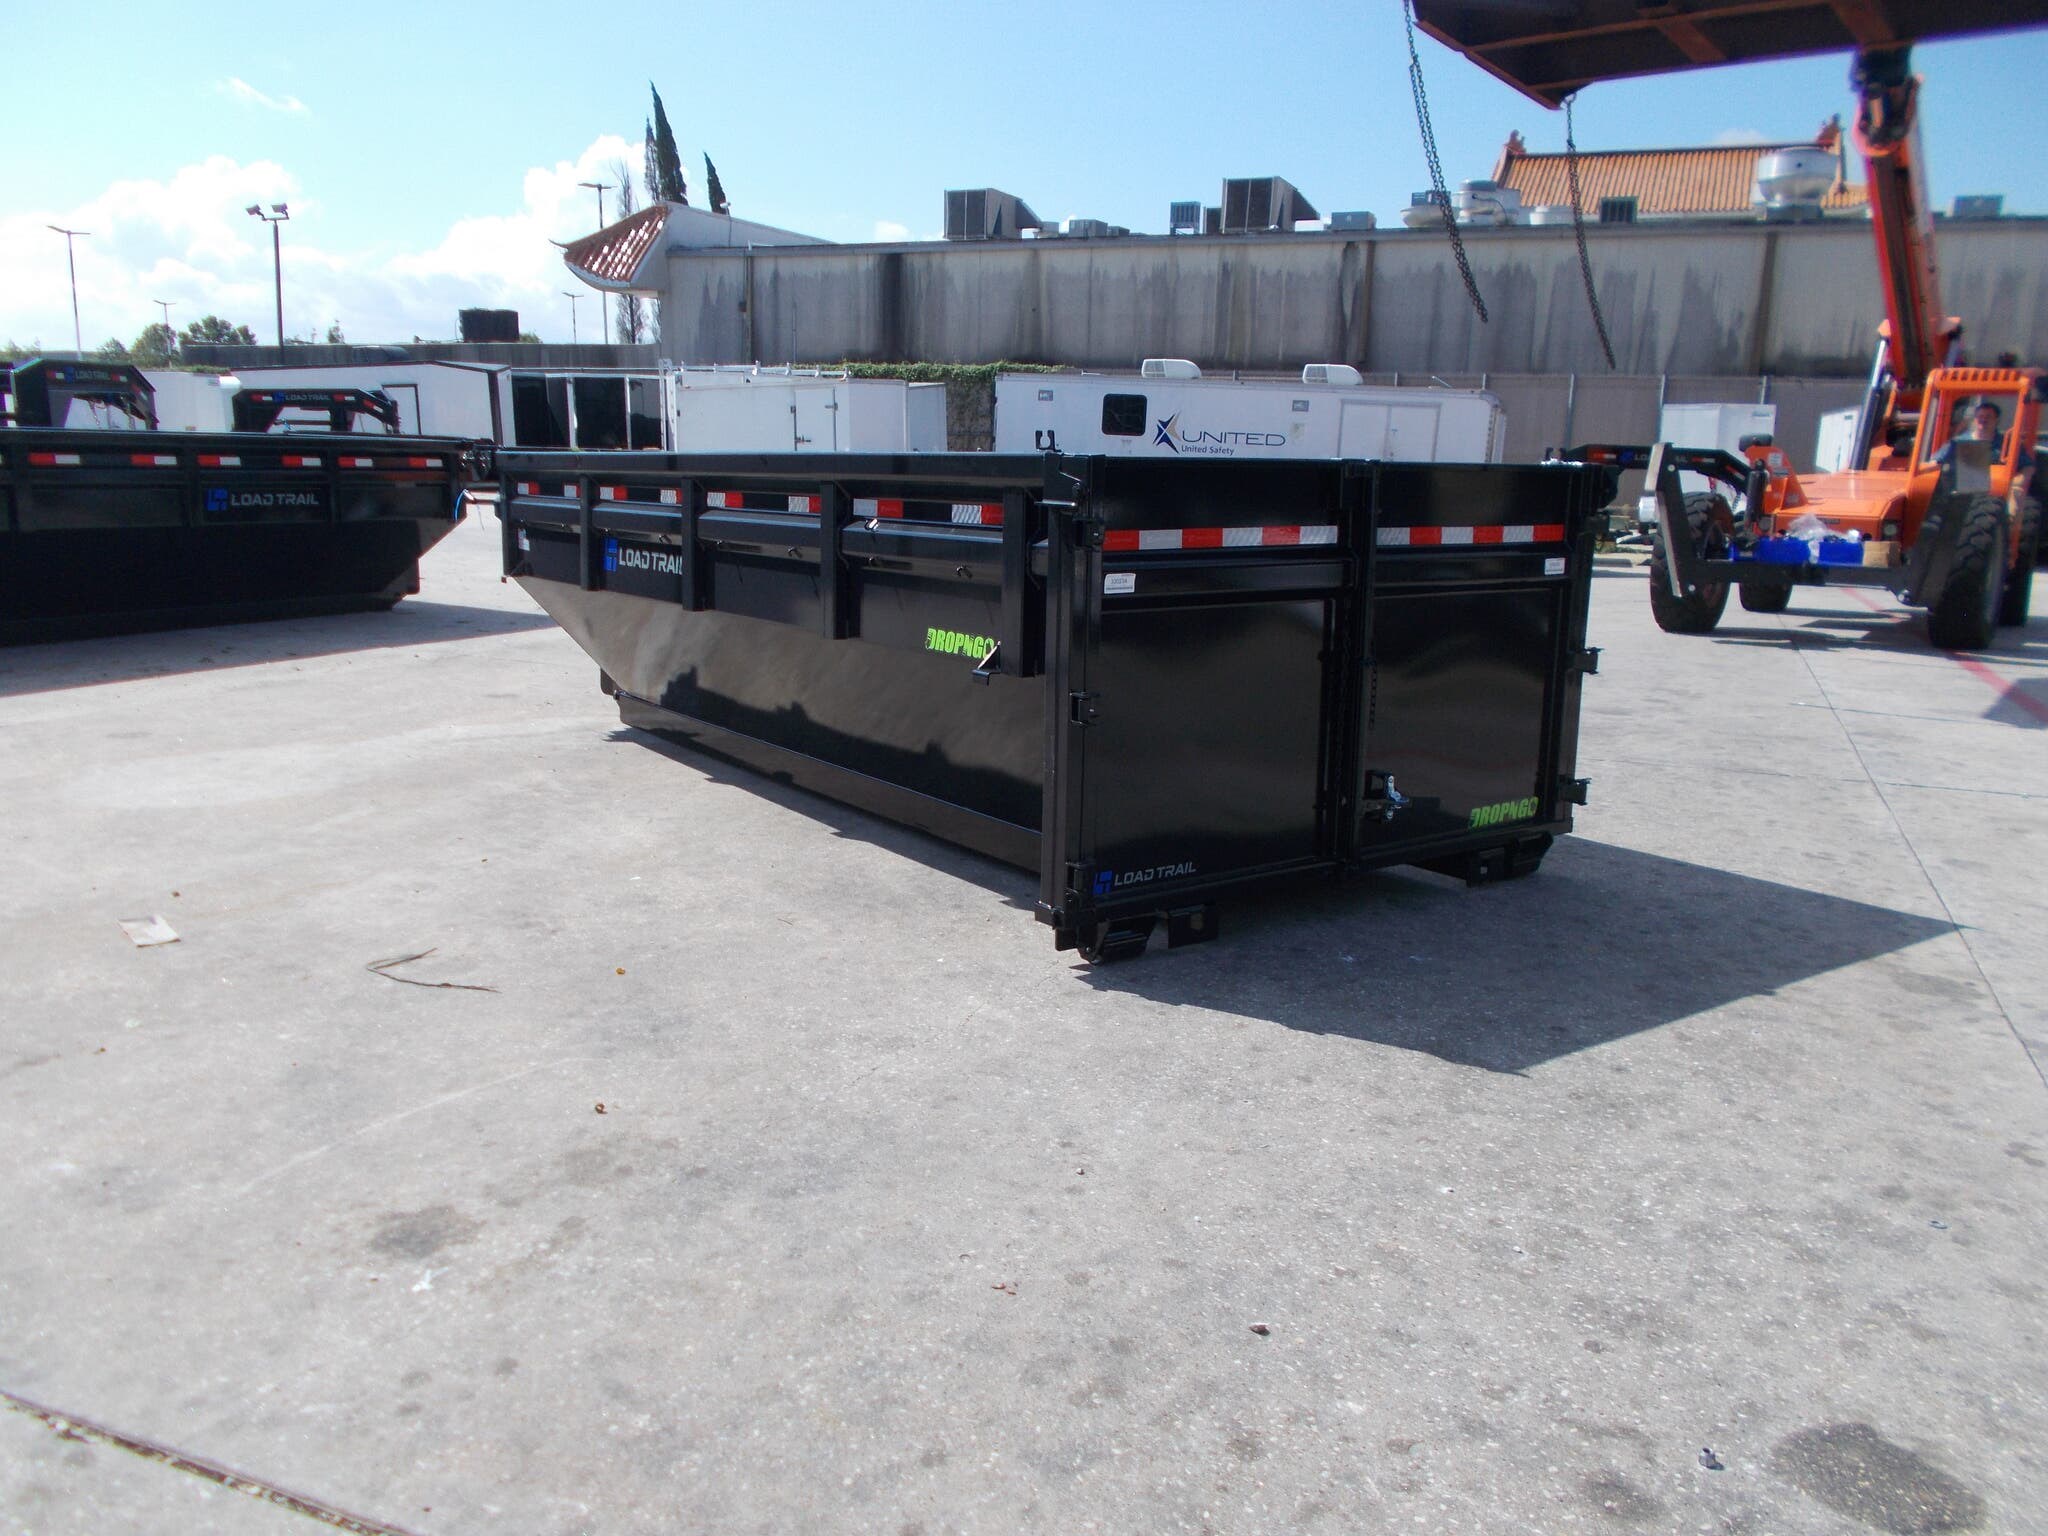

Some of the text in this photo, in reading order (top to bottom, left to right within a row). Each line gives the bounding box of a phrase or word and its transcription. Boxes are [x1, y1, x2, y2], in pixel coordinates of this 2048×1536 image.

[1182, 430, 1286, 447] UNITED
[1181, 445, 1235, 456] United Safety
[231, 494, 320, 506] LOAD TRAIL
[618, 547, 650, 570] LOAD
[1114, 861, 1197, 887] LOAD TRAIL
